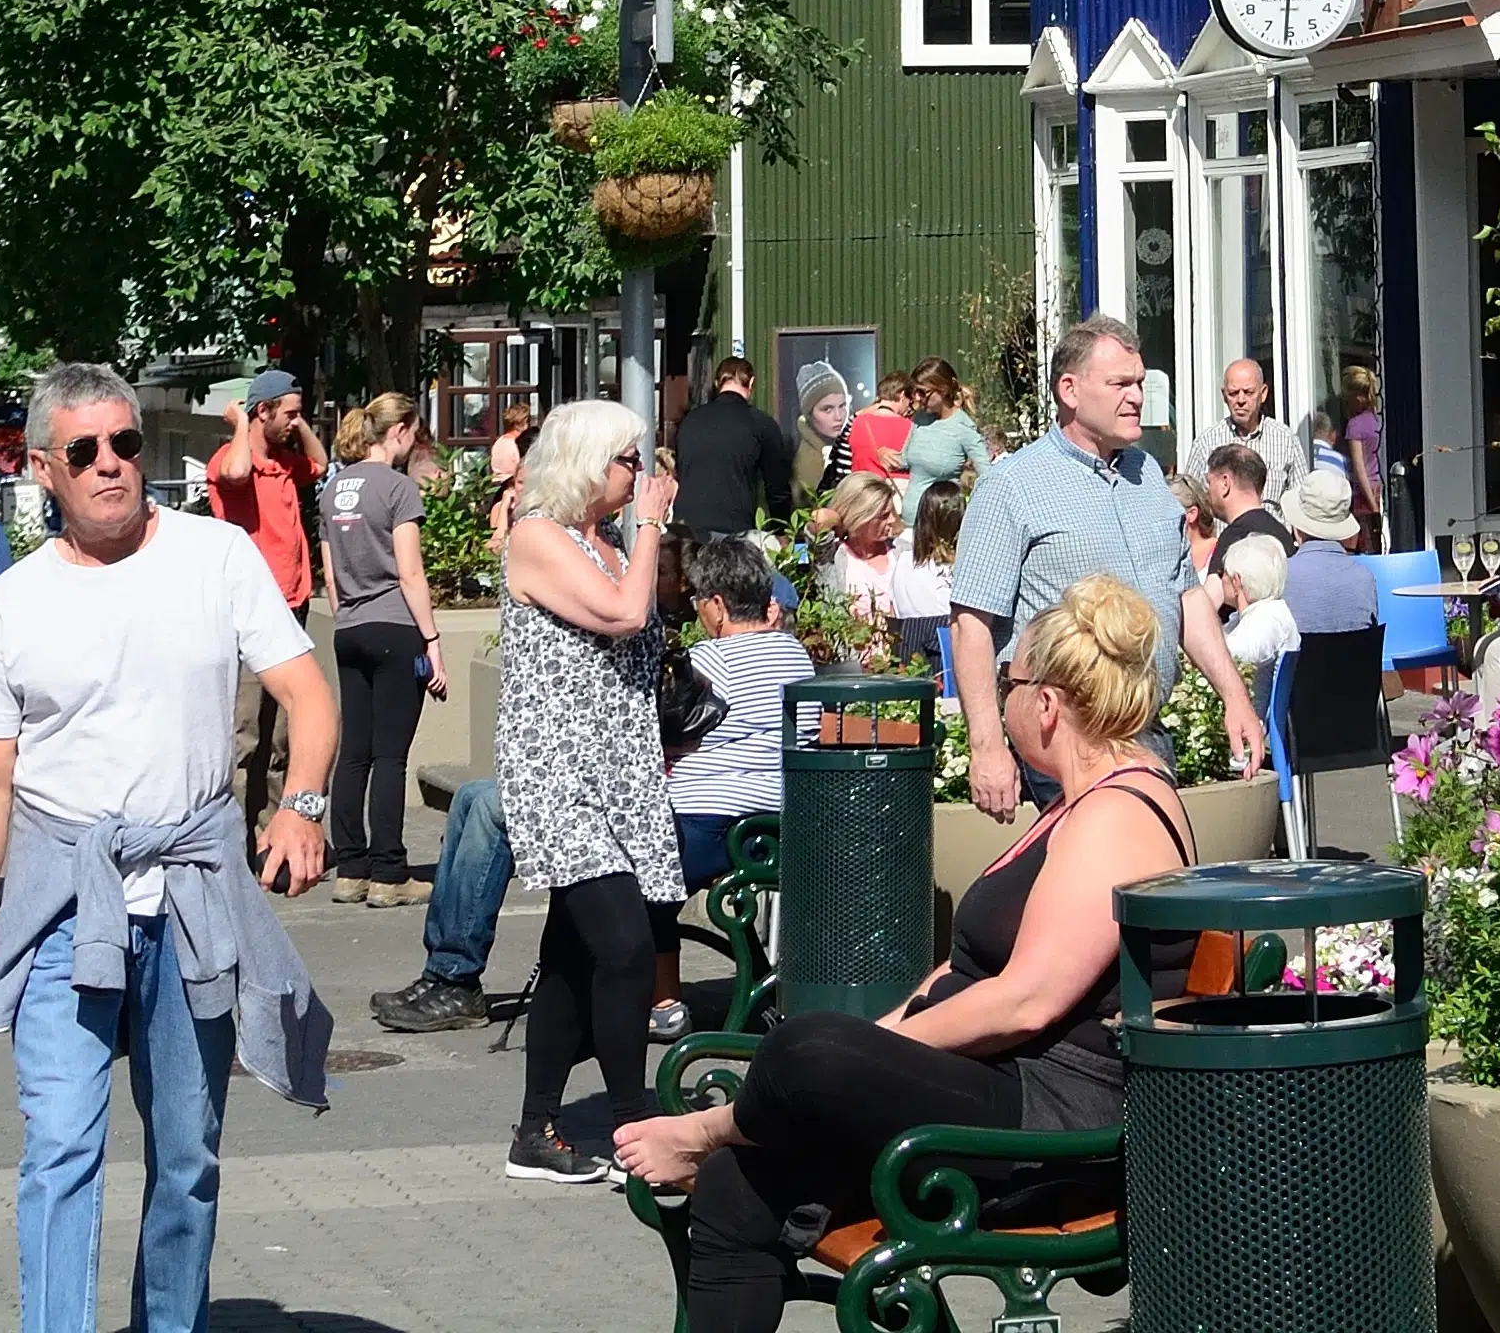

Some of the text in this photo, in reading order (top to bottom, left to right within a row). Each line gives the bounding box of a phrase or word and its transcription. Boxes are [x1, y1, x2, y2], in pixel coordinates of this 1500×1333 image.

[1245, 4, 1256, 15] 8
[1321, 2, 1332, 13] 4
[1264, 20, 1273, 31] 7
[1308, 19, 1317, 30] 5
[336, 477, 366, 493] STAFF
